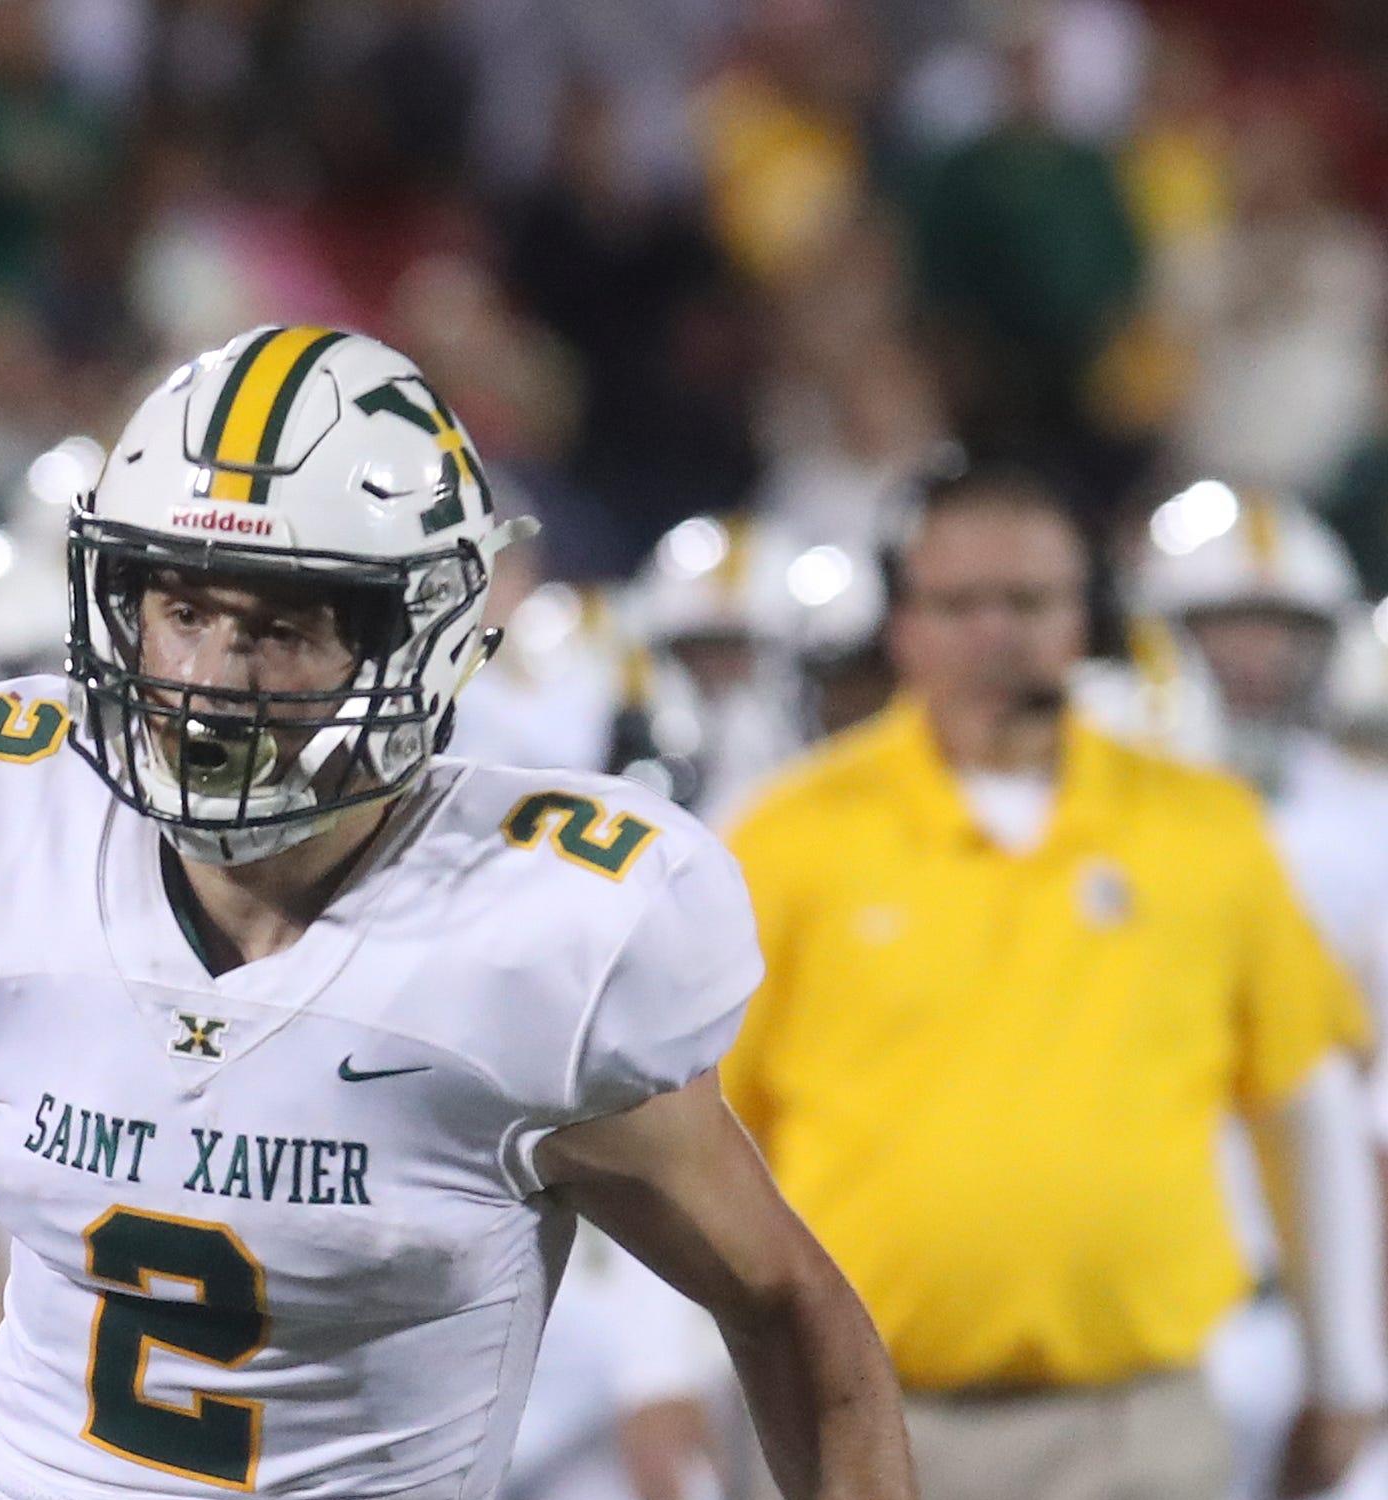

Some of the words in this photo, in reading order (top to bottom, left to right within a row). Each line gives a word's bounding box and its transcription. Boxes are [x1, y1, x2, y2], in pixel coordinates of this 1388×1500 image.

[500, 789, 663, 883] 2
[23, 1092, 156, 1183] SAINT
[183, 1128, 372, 1205] XAVIER
[80, 1203, 270, 1492] 2
